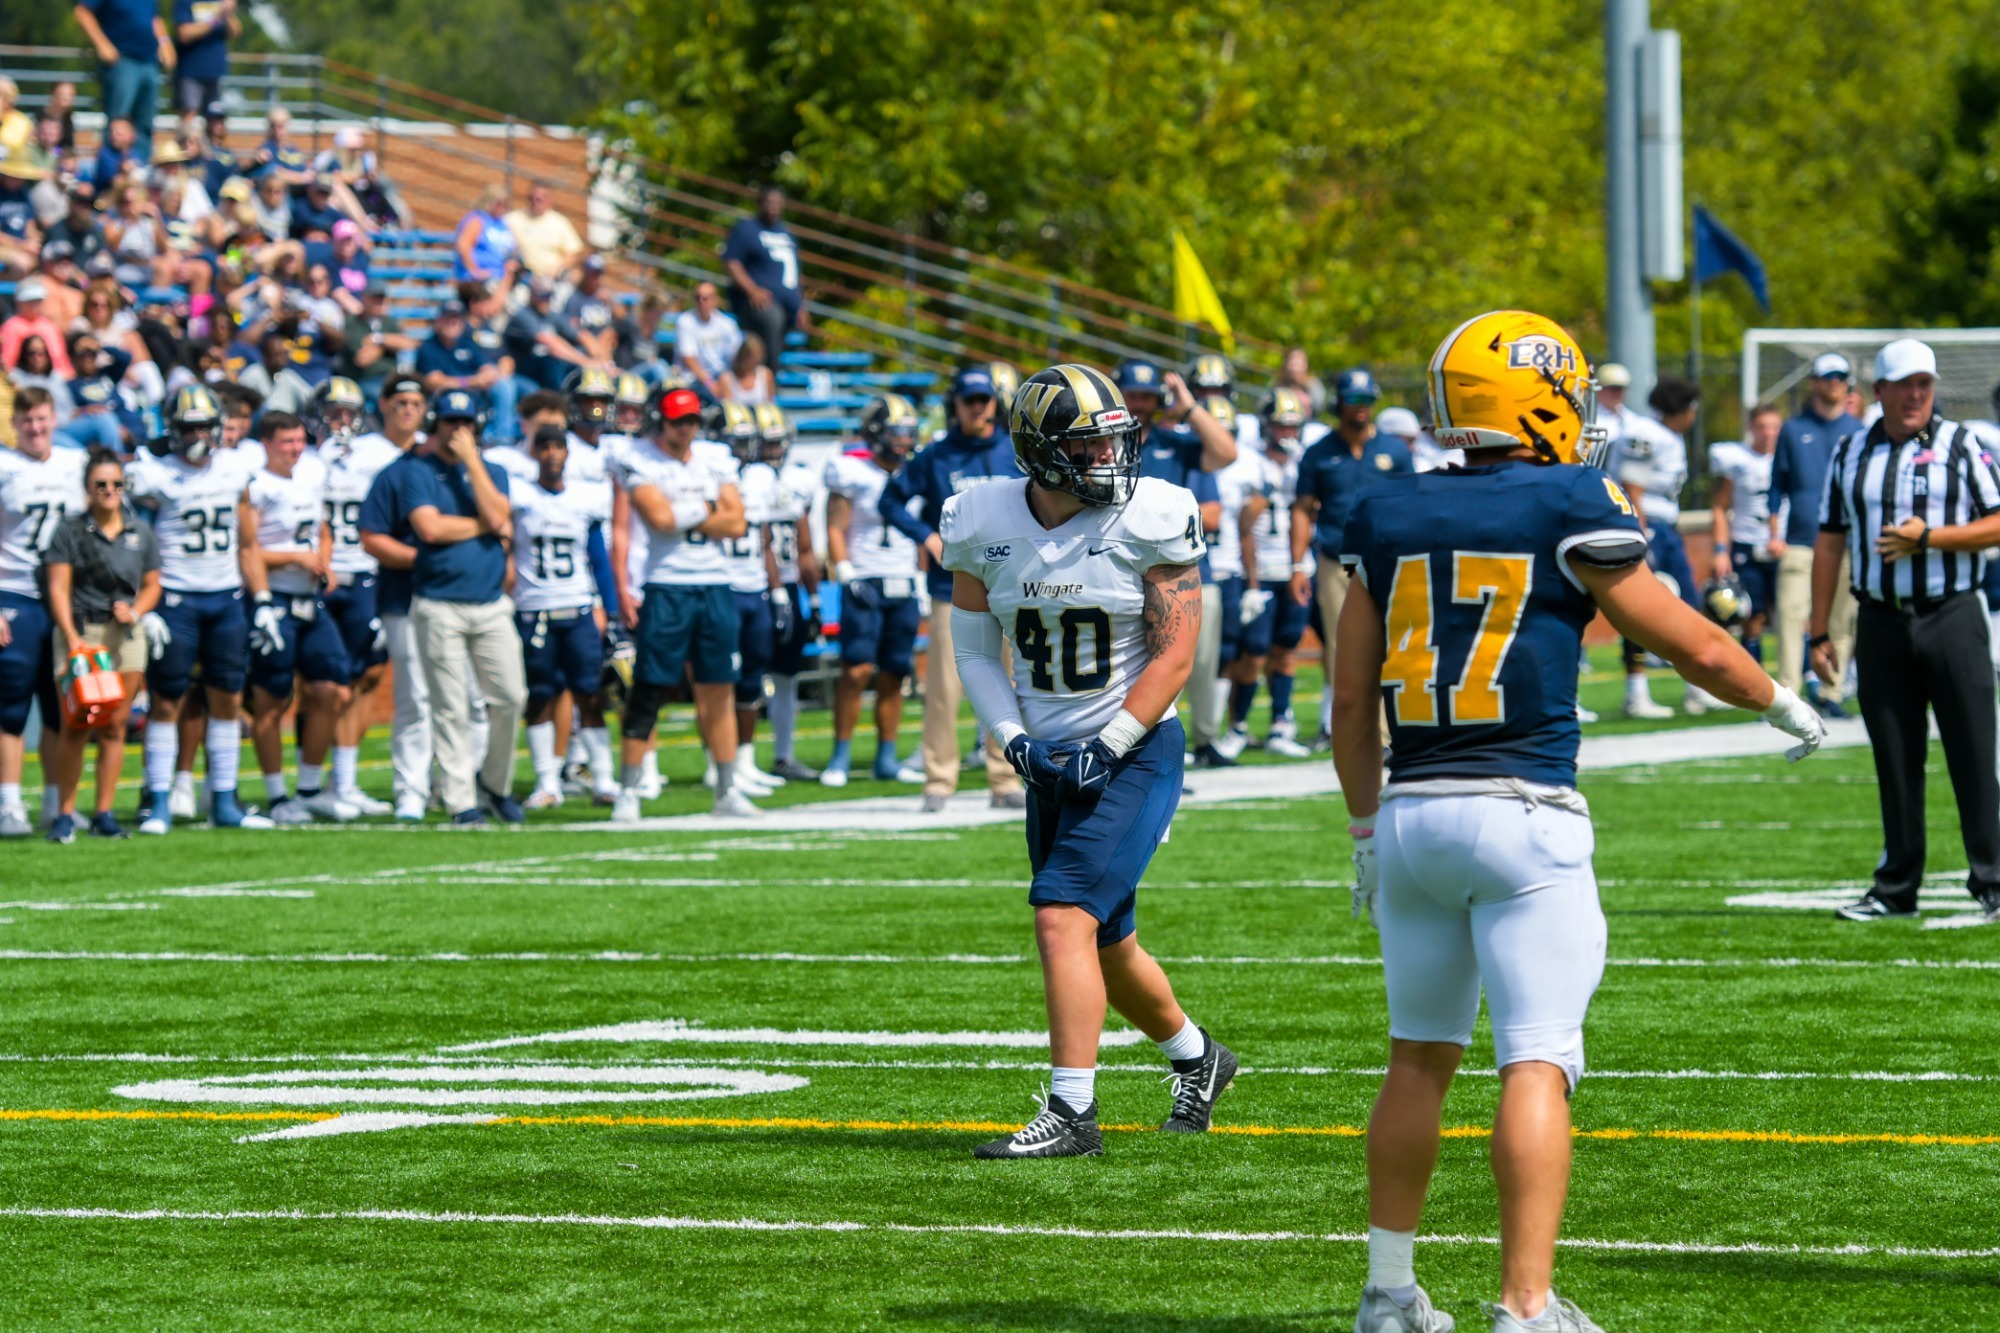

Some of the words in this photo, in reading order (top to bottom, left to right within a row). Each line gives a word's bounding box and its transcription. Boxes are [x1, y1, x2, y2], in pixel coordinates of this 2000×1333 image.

[1508, 341, 1576, 372] E&H
[1104, 412, 1124, 422] Riddell
[1440, 430, 1480, 448] ddell
[180, 505, 233, 555] 35
[530, 534, 577, 579] 15
[986, 544, 1012, 558] SAC
[1023, 581, 1084, 598] Wingate
[1015, 605, 1115, 693] 40
[1381, 550, 1535, 727] 47
